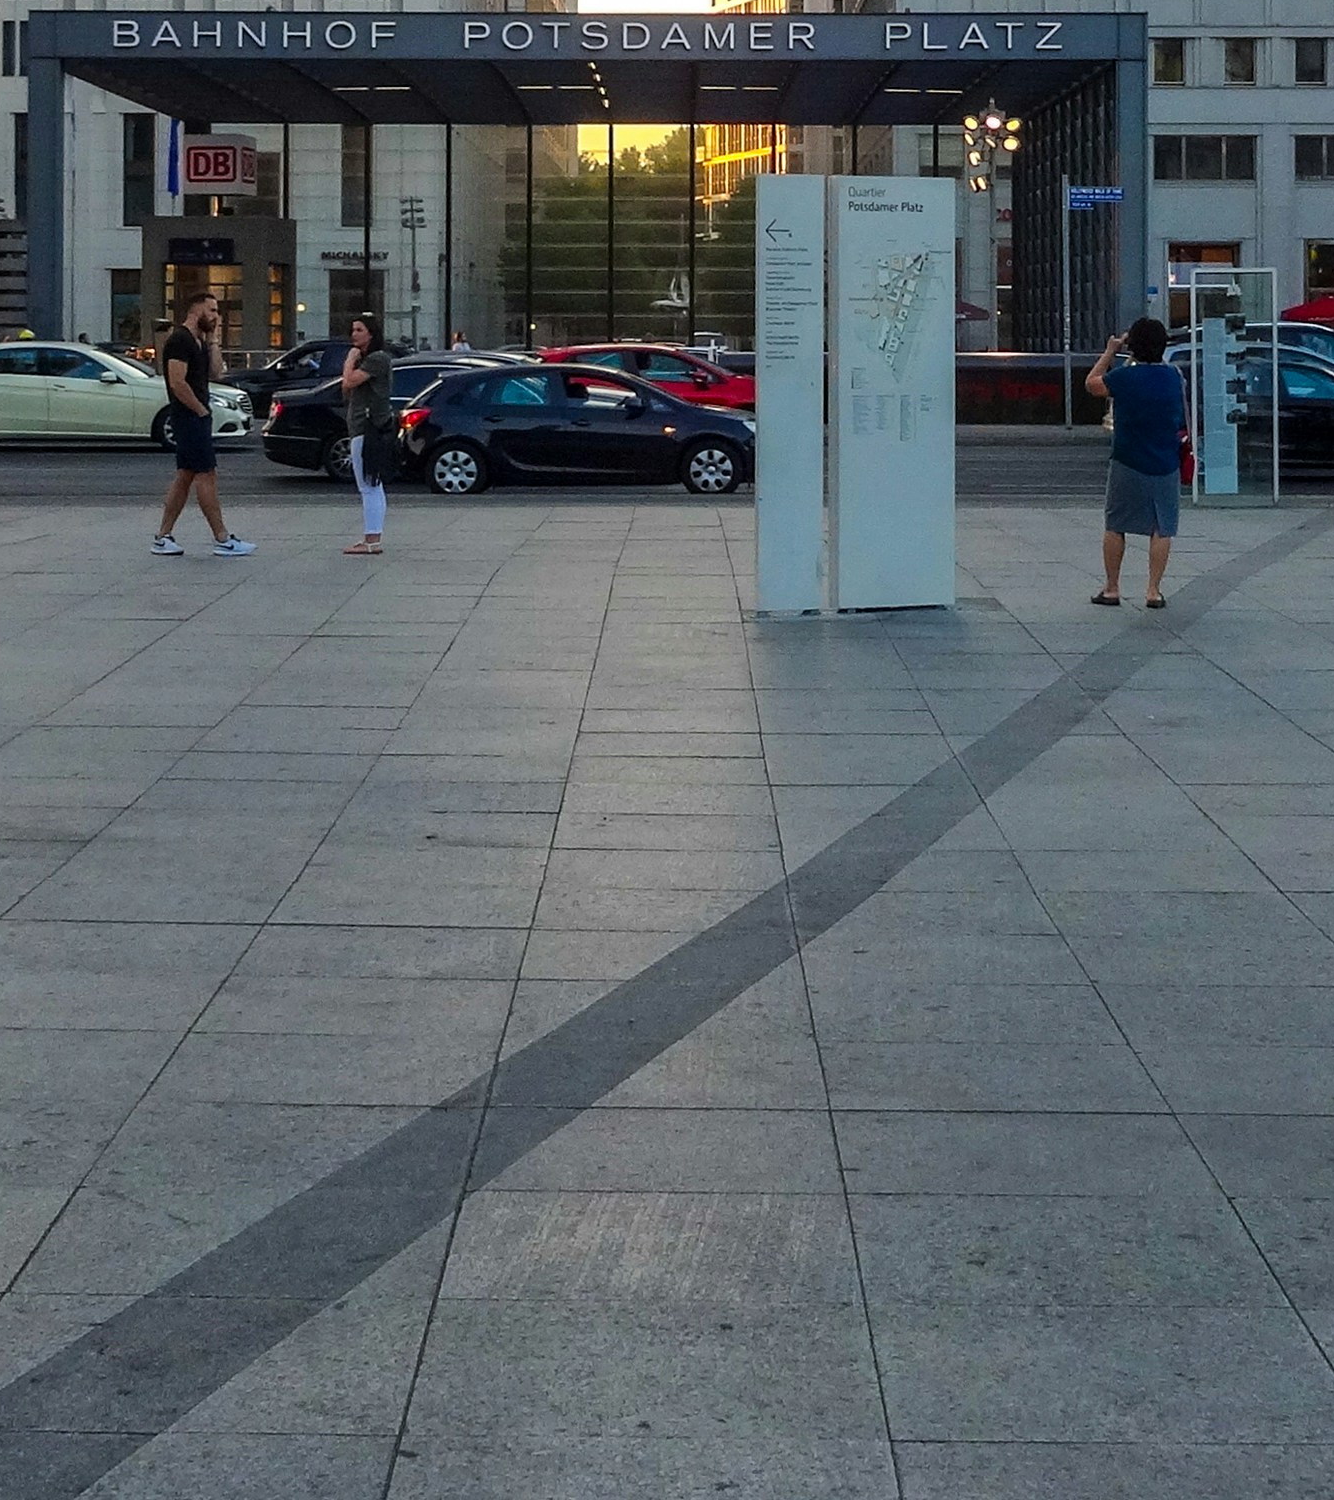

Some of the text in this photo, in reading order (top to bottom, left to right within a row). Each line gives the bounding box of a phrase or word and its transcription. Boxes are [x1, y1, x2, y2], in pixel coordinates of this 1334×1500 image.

[112, 19, 1064, 49] BAHNHOF POTSDAMER PLATZ
[192, 152, 230, 176] DB
[848, 186, 886, 198] Quartier
[848, 201, 924, 213] Potsdamer Platz
